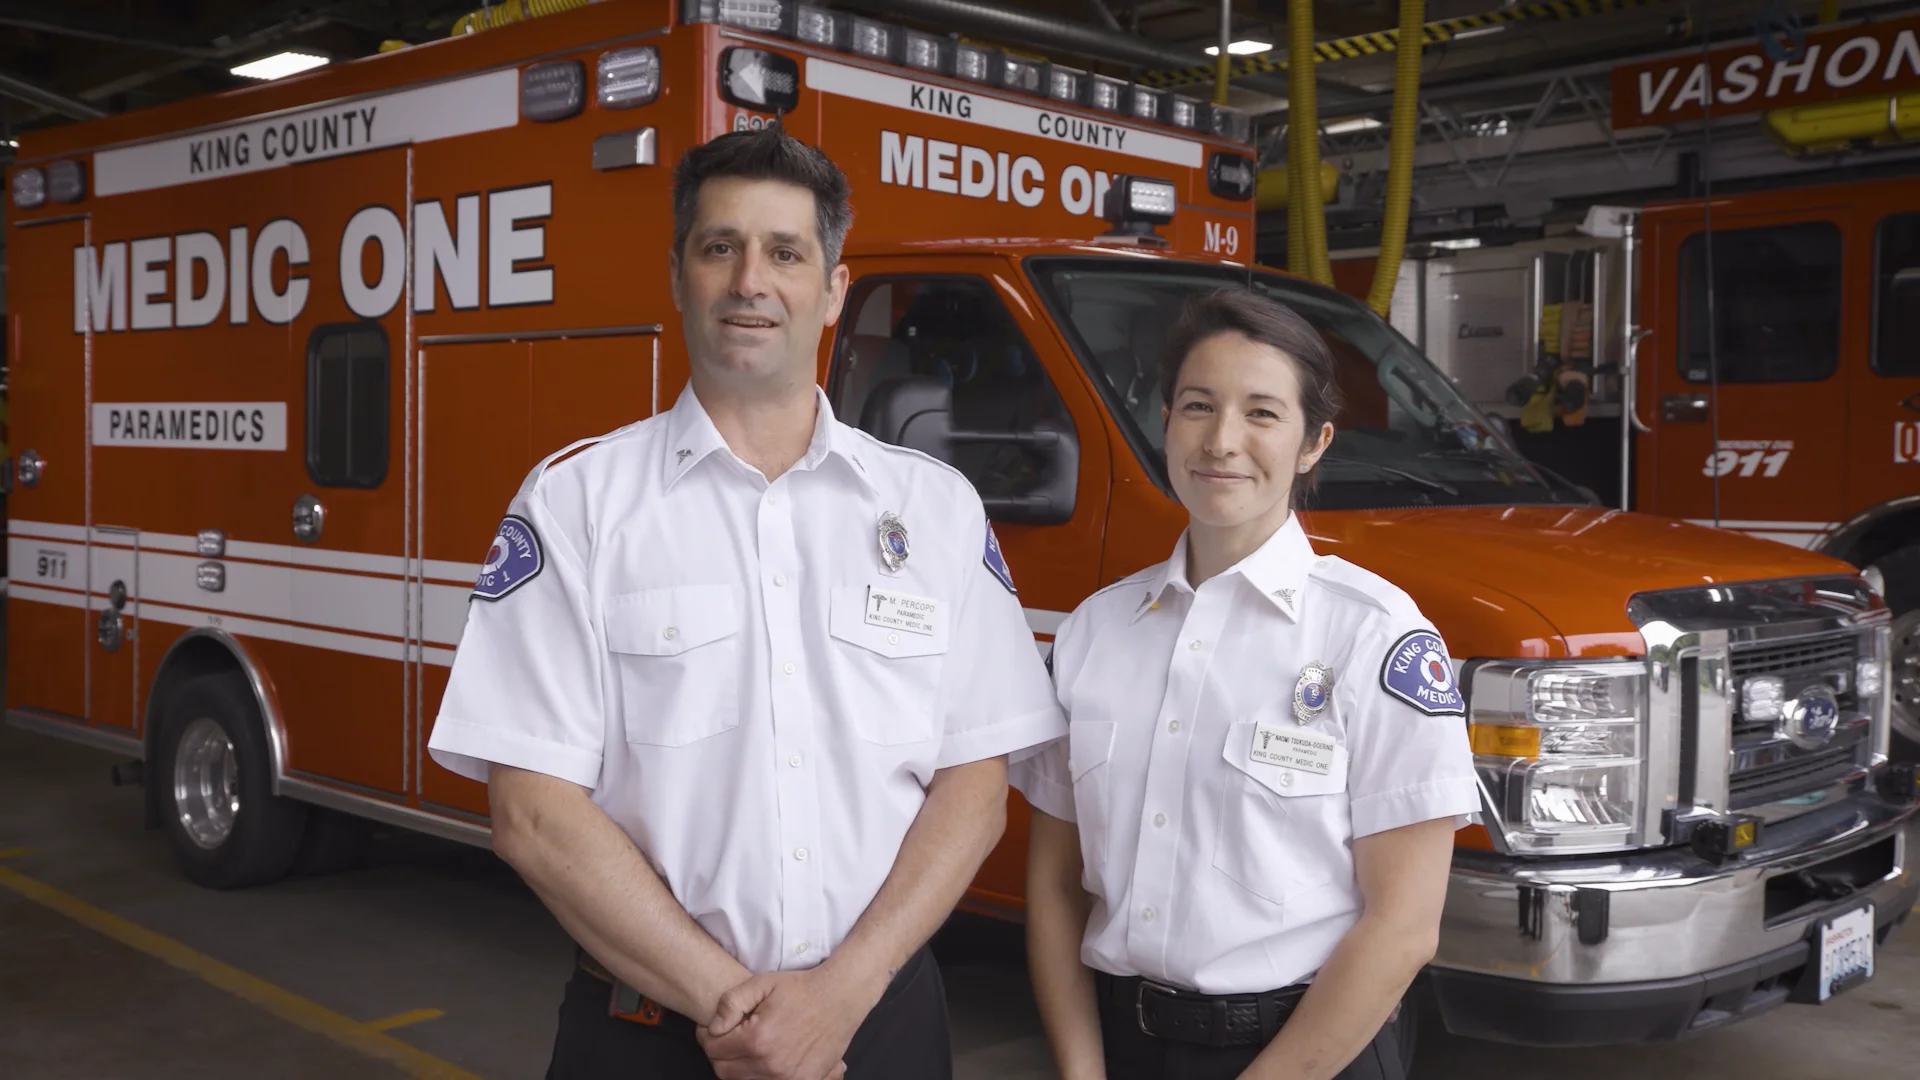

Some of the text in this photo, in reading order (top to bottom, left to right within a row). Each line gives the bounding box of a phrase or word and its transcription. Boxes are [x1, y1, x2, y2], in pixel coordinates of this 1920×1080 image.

[910, 84, 1127, 149] KING COUNTY
[190, 106, 376, 174] KING COUNTY
[880, 129, 1120, 218] MEDIC ON
[1203, 220, 1239, 256] M-9
[73, 180, 554, 333] MEDIC ONE
[109, 409, 265, 443] PARAMEDICS
[1701, 449, 1791, 477] 911
[499, 525, 532, 559] COUNTY
[36, 555, 67, 580] 911
[896, 609, 925, 621] PARAMEDIC
[900, 599, 936, 613] PERCOPO
[869, 613, 933, 632] KING COUNTY MEDIC ONE
[1394, 642, 1422, 675] KING
[1416, 684, 1457, 705] MEDIC
[1275, 735, 1290, 743] NAOMI
[1253, 750, 1329, 770] KING COUNTY MEDIC ONE
